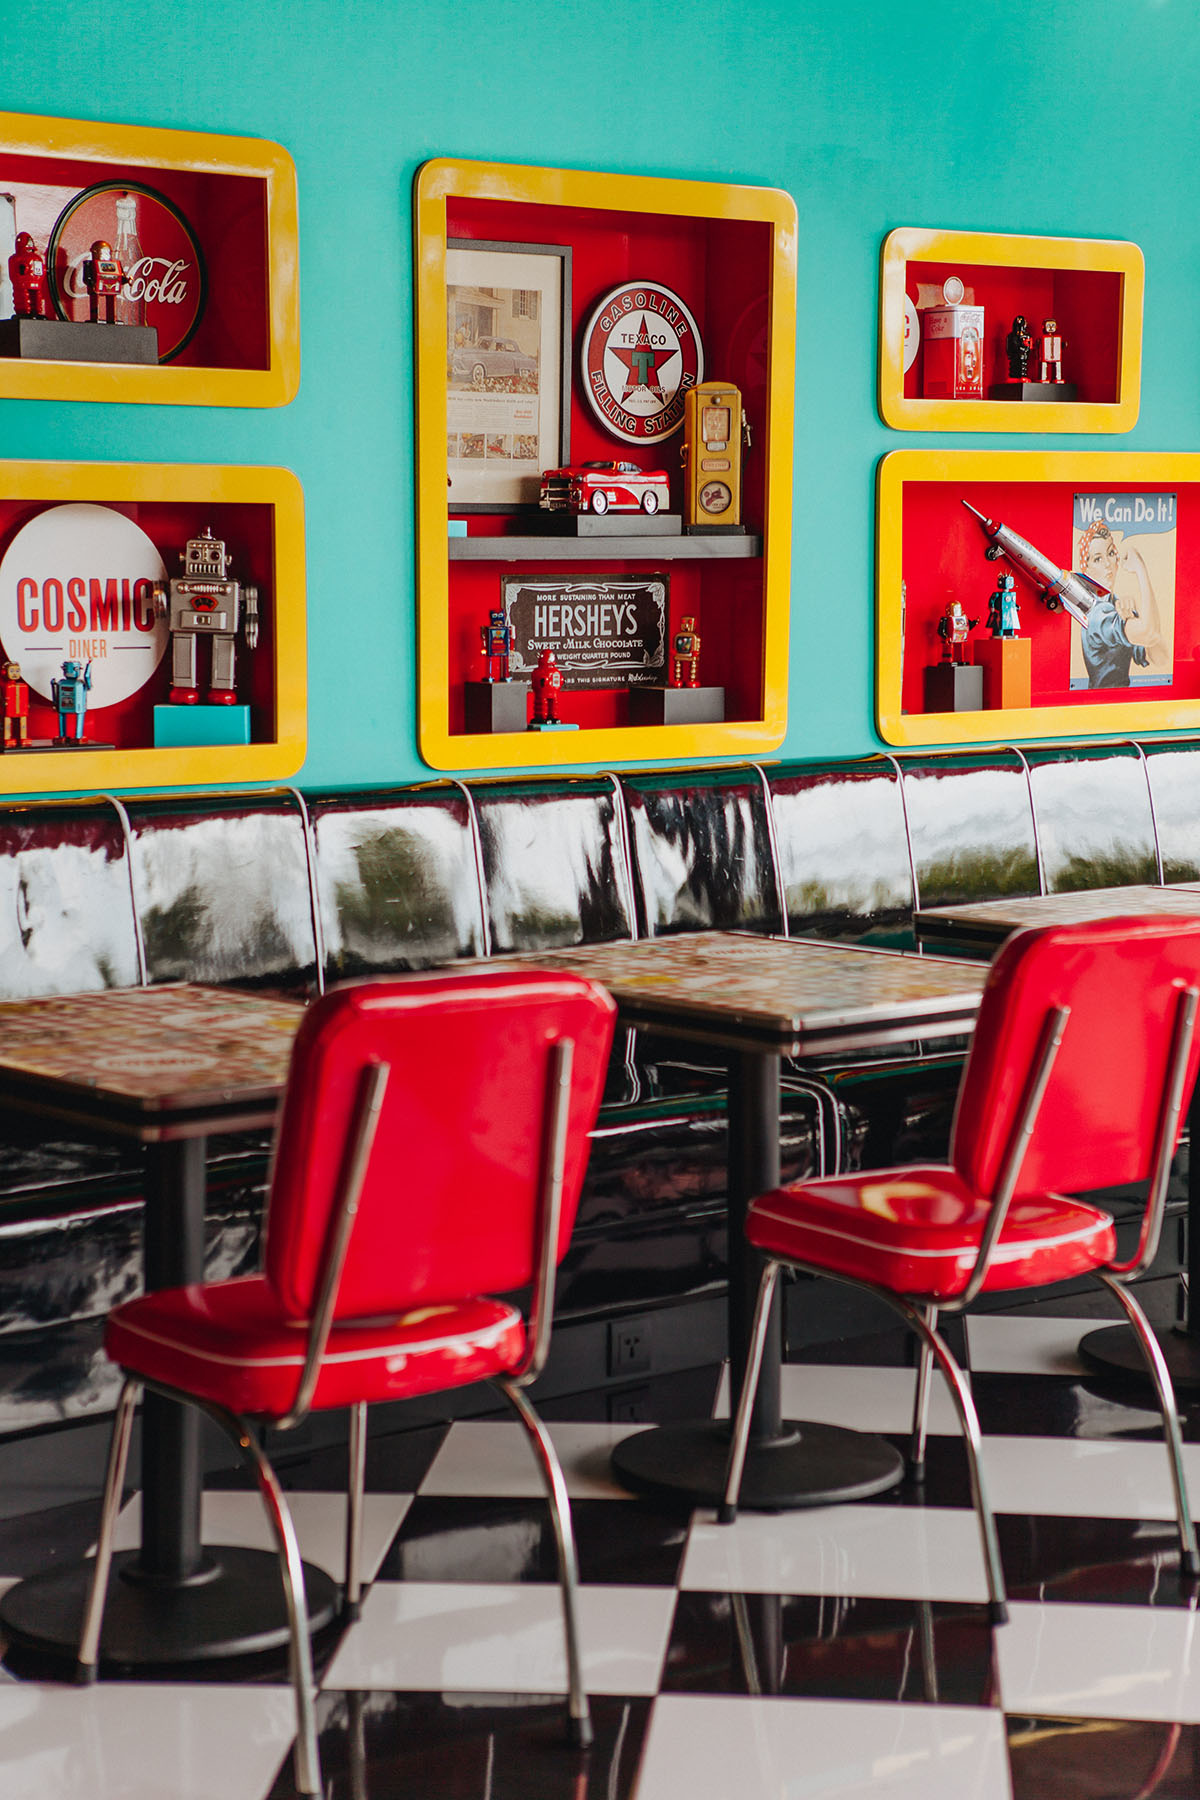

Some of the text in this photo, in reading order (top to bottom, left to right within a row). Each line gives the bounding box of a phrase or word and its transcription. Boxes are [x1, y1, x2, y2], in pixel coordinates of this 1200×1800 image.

[600, 293, 688, 337] GASOLINE
[620, 333, 667, 346] TEXACO
[631, 351, 655, 385] T
[592, 370, 637, 434] FILLING
[621, 385, 666, 394] MOTOR OILS
[1080, 497, 1173, 523] We Can Do It!
[17, 577, 155, 633] COSMIC
[534, 601, 638, 638] HERSHEY'S
[69, 639, 107, 659] DINER
[557, 652, 631, 661] WEIGHT QUARTER POUND
